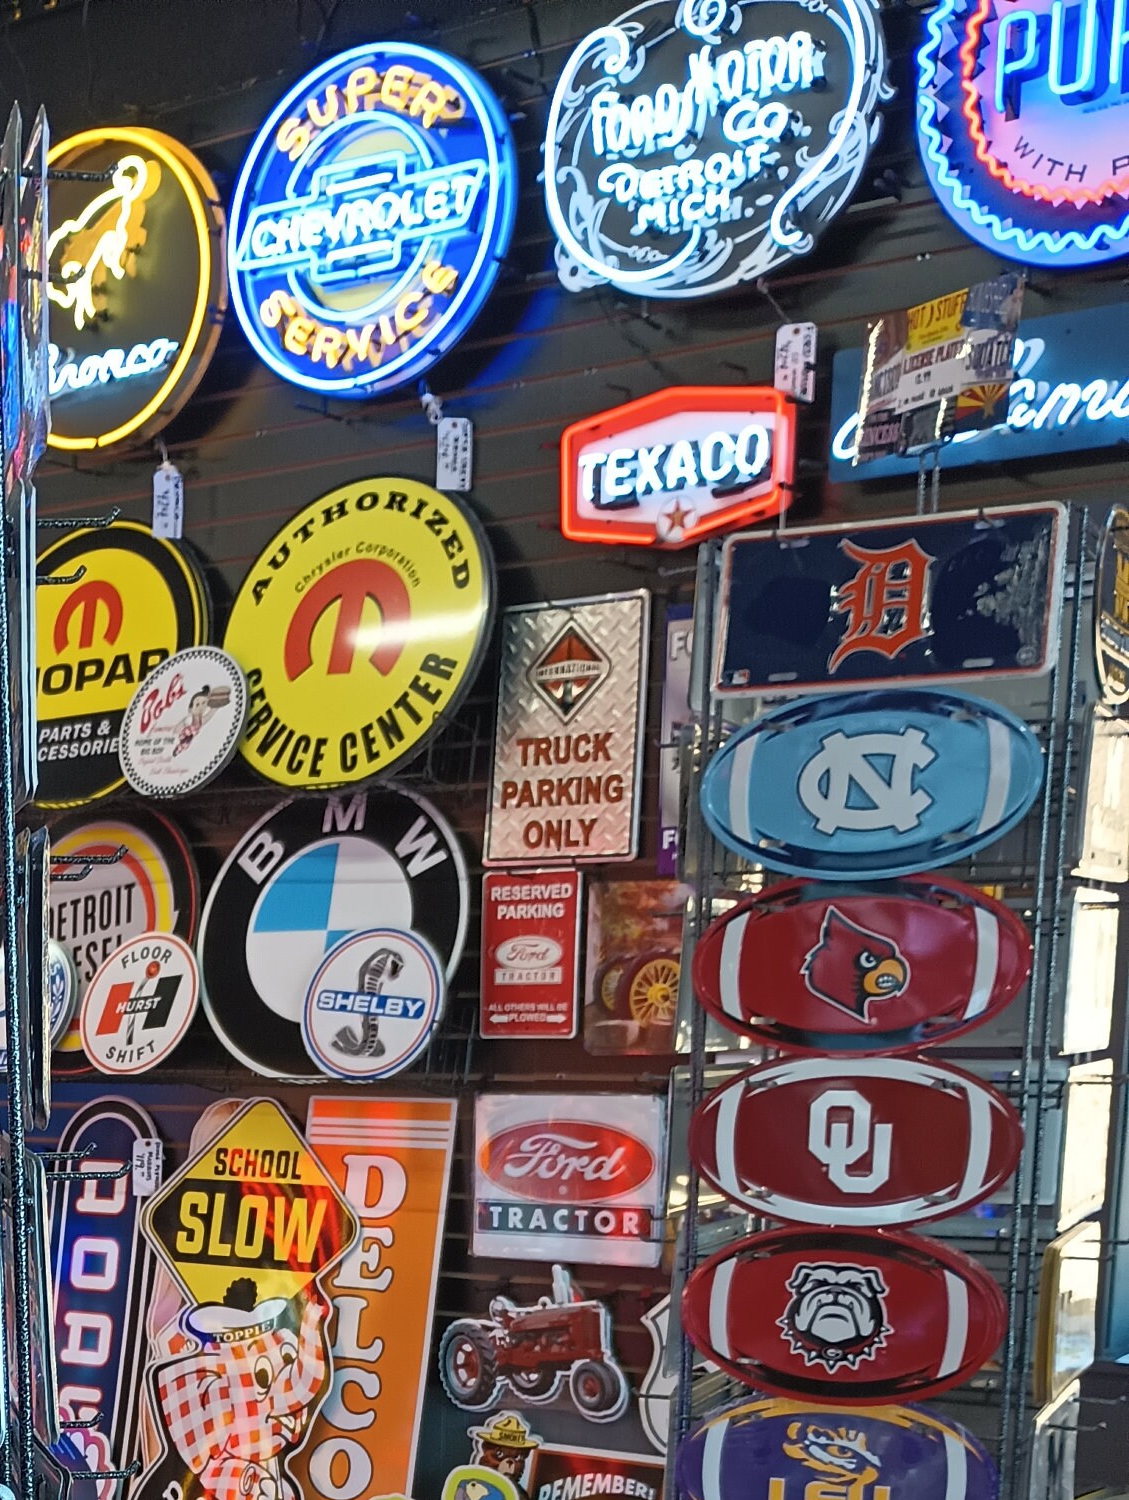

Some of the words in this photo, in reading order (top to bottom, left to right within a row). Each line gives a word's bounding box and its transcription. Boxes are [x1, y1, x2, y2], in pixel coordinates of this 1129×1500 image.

[276, 64, 450, 162] SUPER
[598, 142, 769, 202] DETROIT
[1014, 136, 1087, 182] WITH
[252, 176, 473, 258] CHEVROLET
[260, 260, 459, 368] SERVICE
[578, 424, 771, 501] TEXACO
[250, 491, 470, 606] AUTHORIZED
[294, 545, 351, 593] Chrysler
[355, 541, 422, 588] Corporation
[36, 648, 170, 698] OPAR
[245, 668, 328, 778] SERVICE
[339, 652, 459, 773] CENTER
[38, 723, 92, 744] PARTS
[97, 720, 112, 735] &
[38, 738, 120, 762] CESSORIE
[516, 732, 615, 767] TRUCK
[500, 774, 623, 808] PARKING
[523, 818, 598, 851] ONLY
[491, 883, 573, 901] RESERVED
[497, 903, 565, 920] PARKING
[121, 946, 172, 970] FLOOR
[506, 944, 548, 961] Ford
[502, 971, 555, 981] TRACTOR
[116, 997, 162, 1014] HURST
[317, 992, 424, 1019] SHELBY
[488, 1003, 502, 1012] ALL
[504, 1003, 535, 1012] OTHERS
[537, 1003, 555, 1011] WILL
[556, 1002, 568, 1011] BE
[508, 1013, 547, 1022] PLOWED
[106, 1040, 155, 1063] SHIFT
[502, 1133, 626, 1181] Ford
[807, 1089, 892, 1193] OU
[214, 1148, 301, 1180] SCHOOL
[176, 1191, 327, 1263] SLOW
[489, 1205, 641, 1236] TRACTOR
[213, 1320, 271, 1343] TOPPIE
[309, 1154, 406, 1500] DELCO
